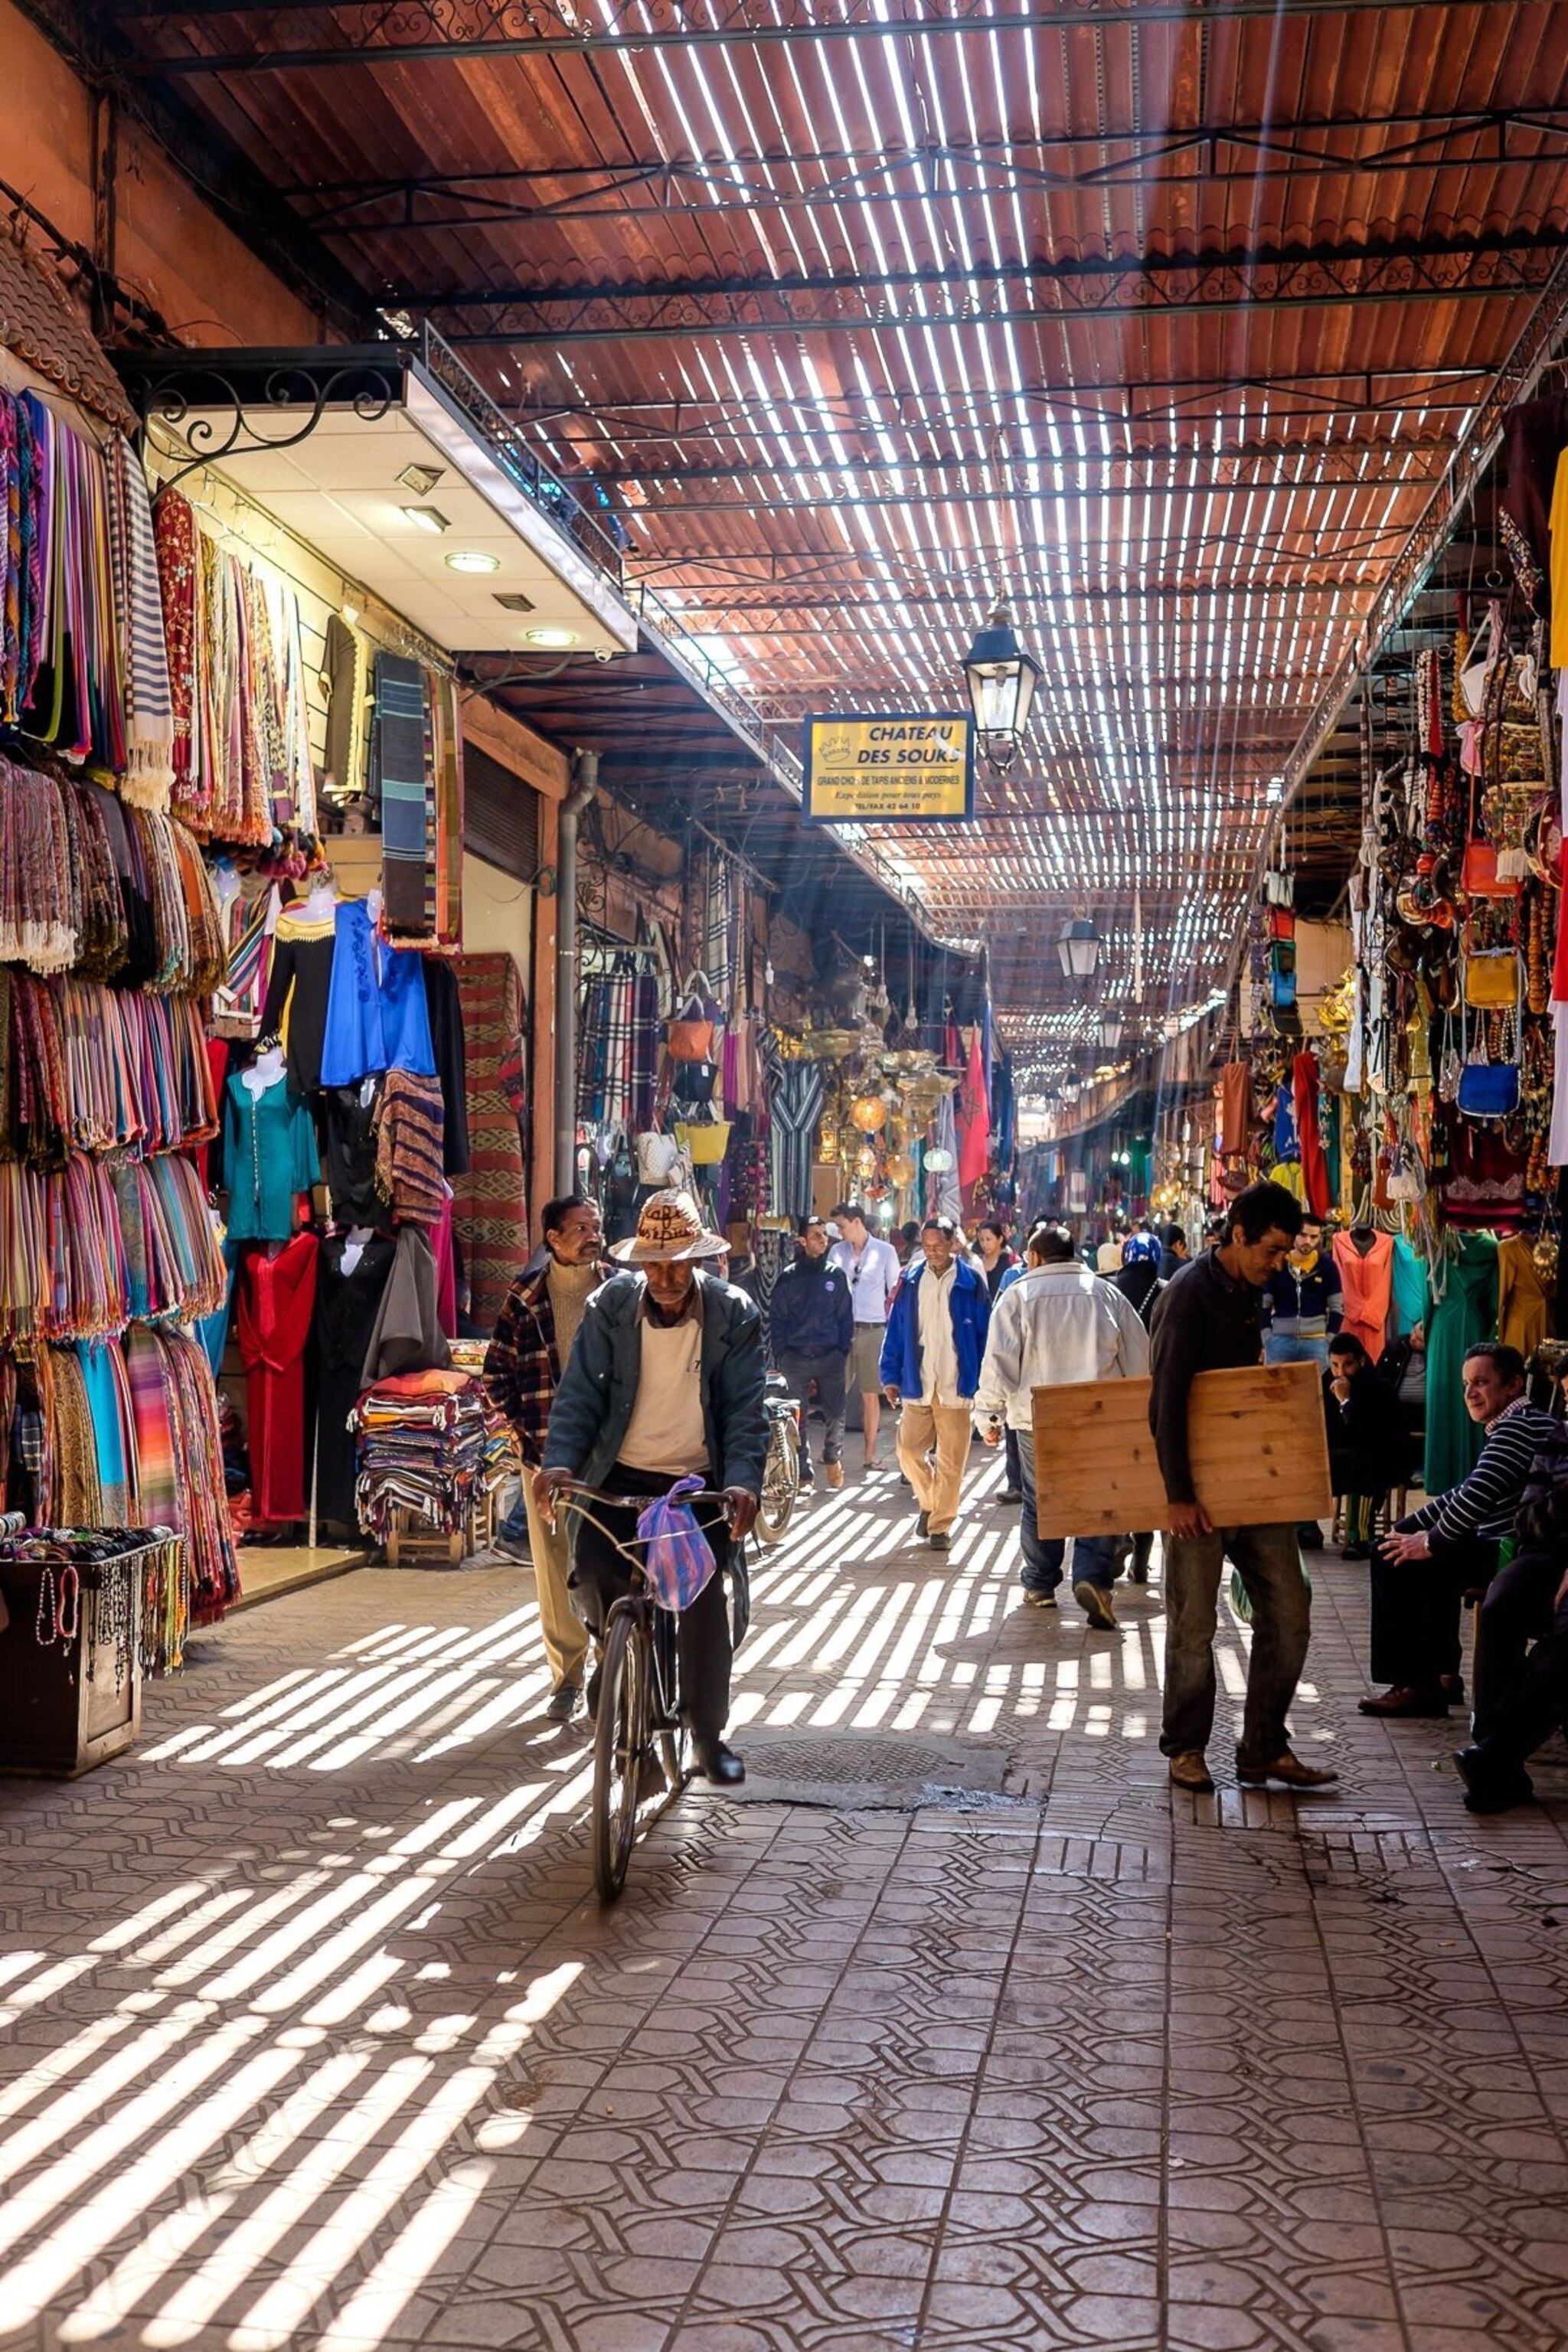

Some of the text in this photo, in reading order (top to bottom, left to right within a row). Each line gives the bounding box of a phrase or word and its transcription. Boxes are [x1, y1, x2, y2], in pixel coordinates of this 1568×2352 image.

[869, 726, 953, 741] CHATEAU
[858, 749, 961, 763] DES SOUKS
[818, 776, 839, 786] GRAND
[840, 776, 858, 786] CHO
[861, 776, 870, 786] DE
[871, 776, 889, 785] TAPIS
[890, 776, 917, 785] ANCIENS
[880, 792, 901, 801] pour
